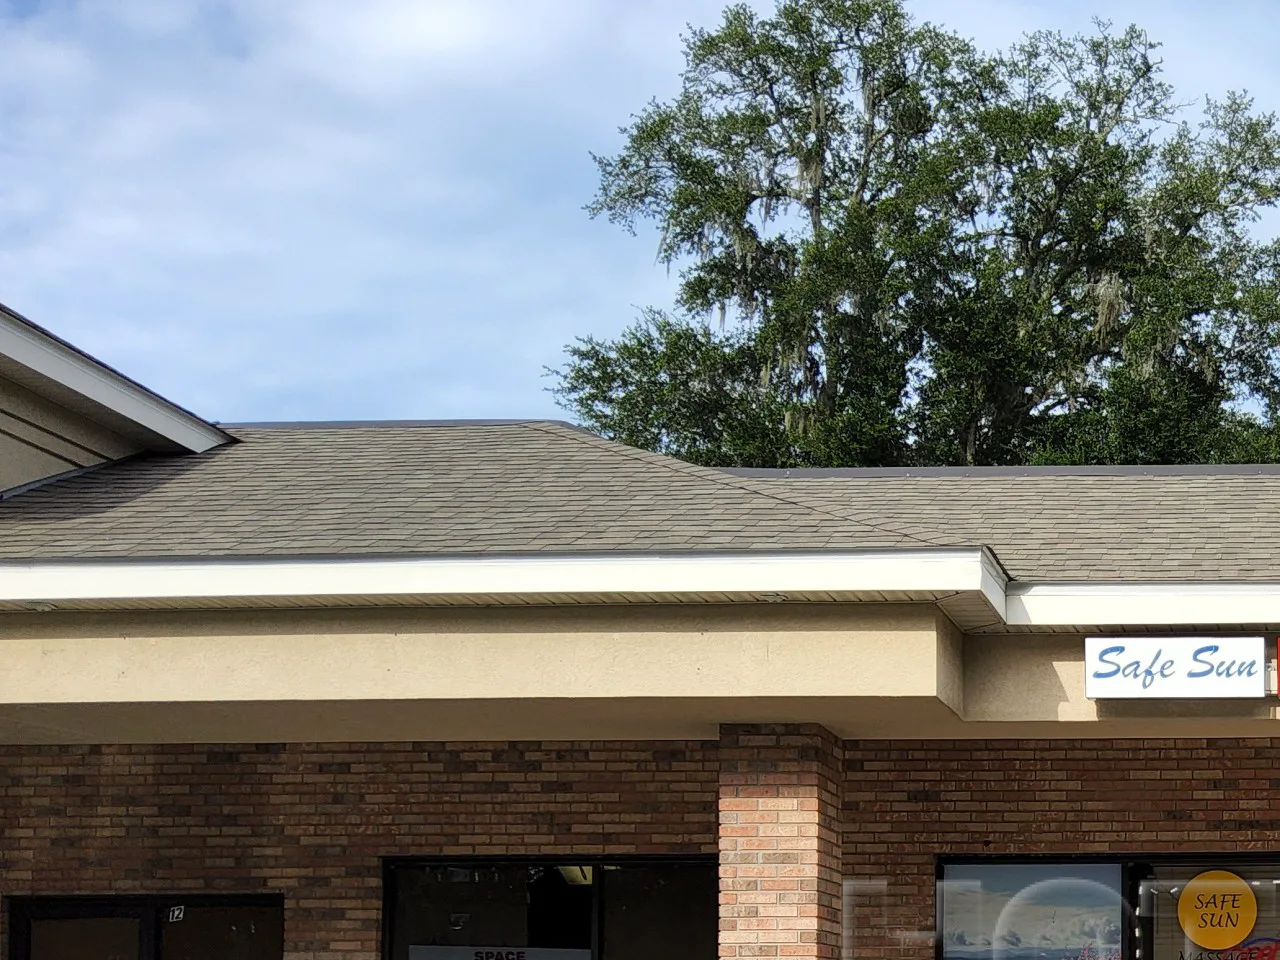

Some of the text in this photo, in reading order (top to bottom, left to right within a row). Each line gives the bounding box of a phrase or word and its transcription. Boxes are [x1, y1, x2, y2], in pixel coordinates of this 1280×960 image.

[1092, 645, 1258, 689] Safe Sun
[1194, 893, 1243, 910] SAFE
[170, 906, 184, 921] 12
[1197, 912, 1240, 929] SUN
